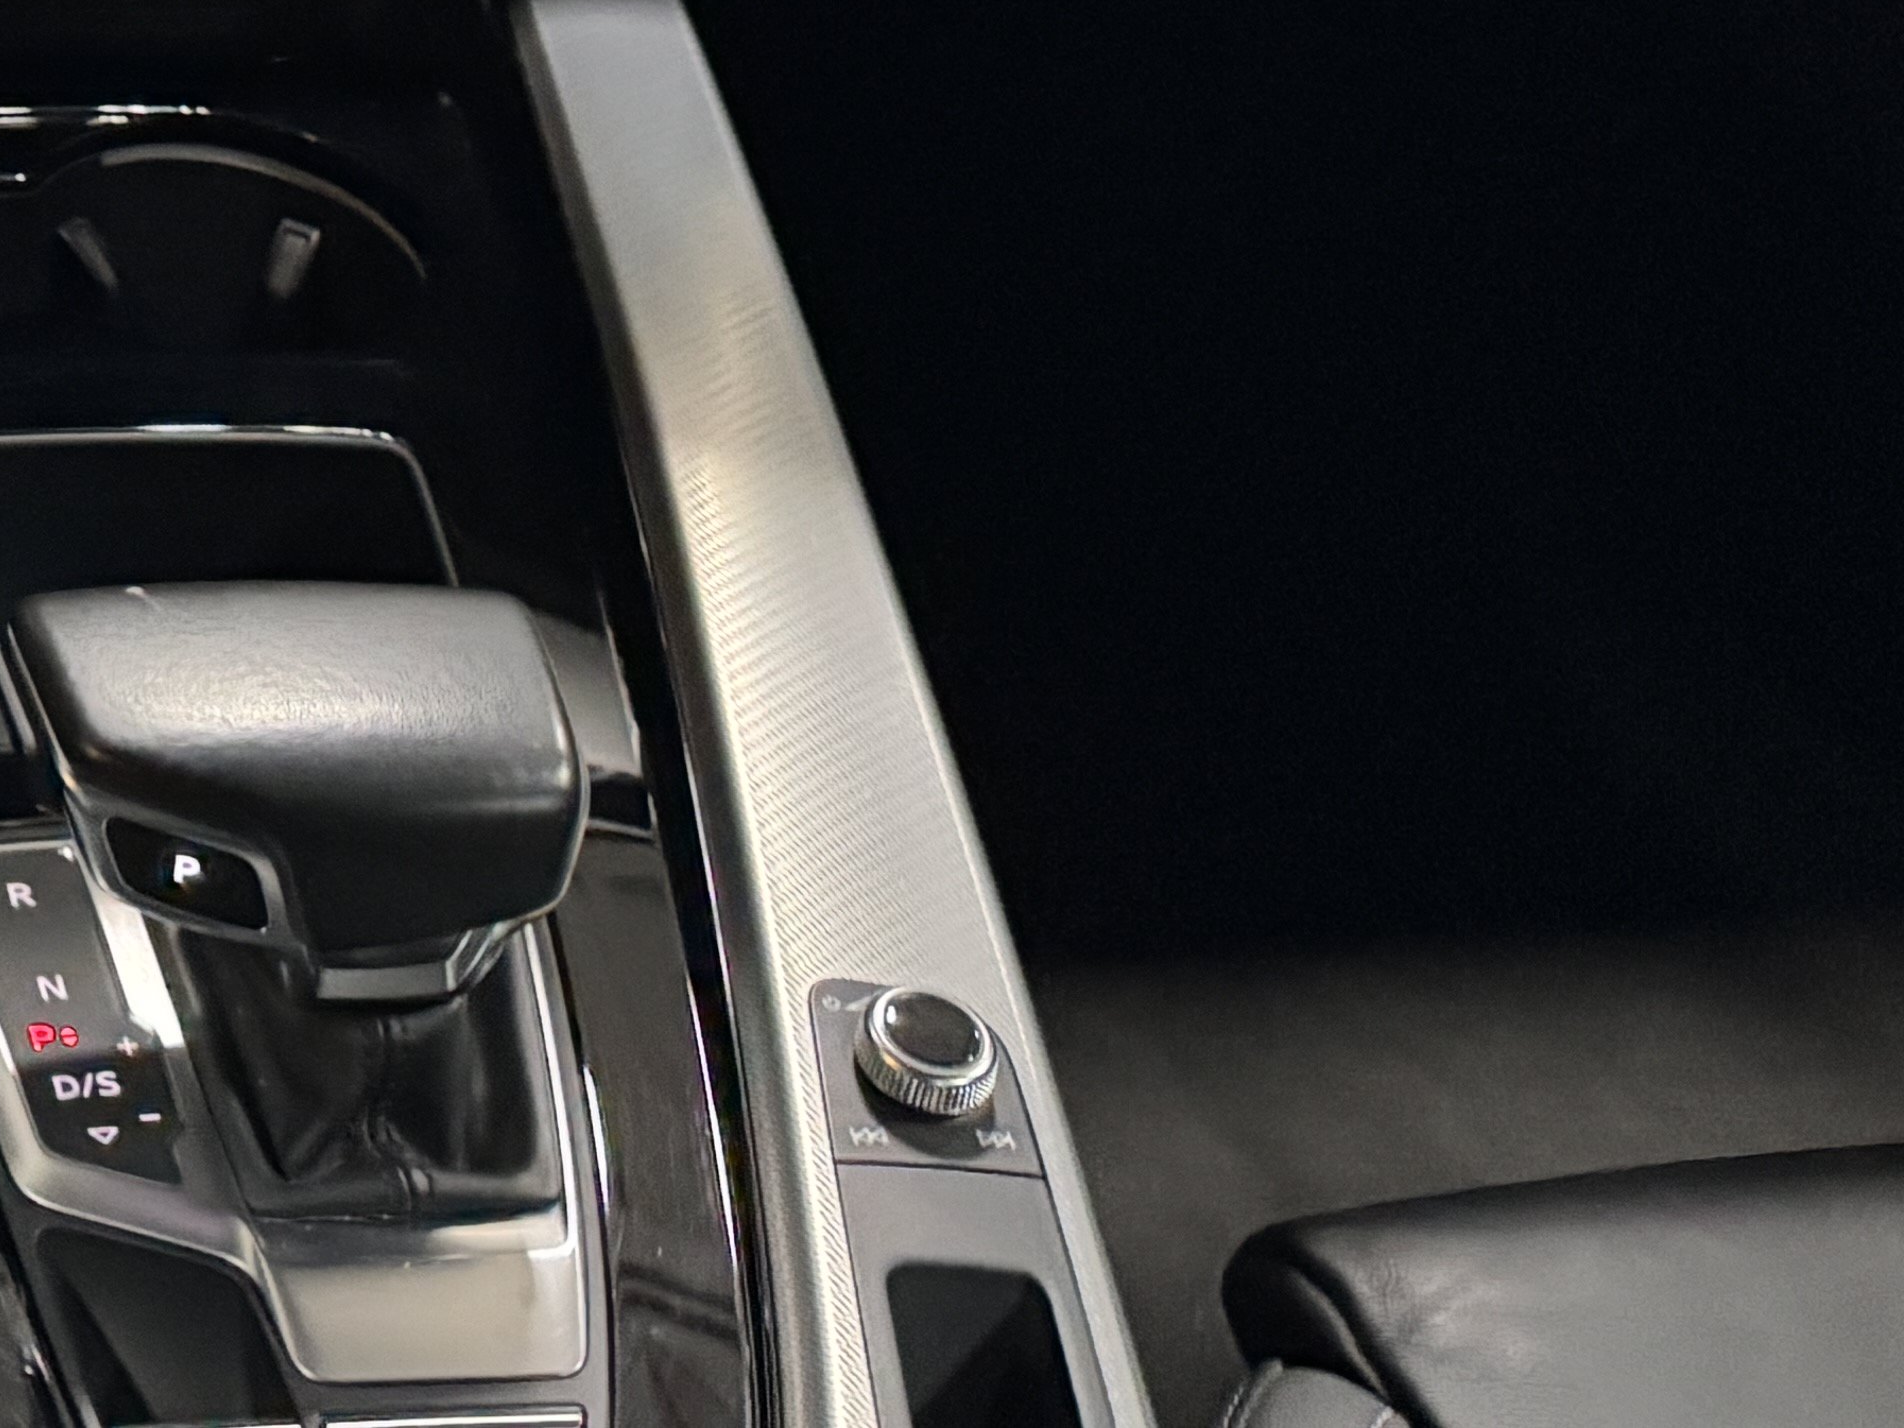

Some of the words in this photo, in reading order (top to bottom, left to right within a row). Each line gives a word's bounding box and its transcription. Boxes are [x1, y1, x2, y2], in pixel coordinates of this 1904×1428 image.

[173, 854, 202, 884] P
[6, 881, 37, 910] R
[36, 973, 69, 1003] N
[51, 1070, 122, 1102] D/S
